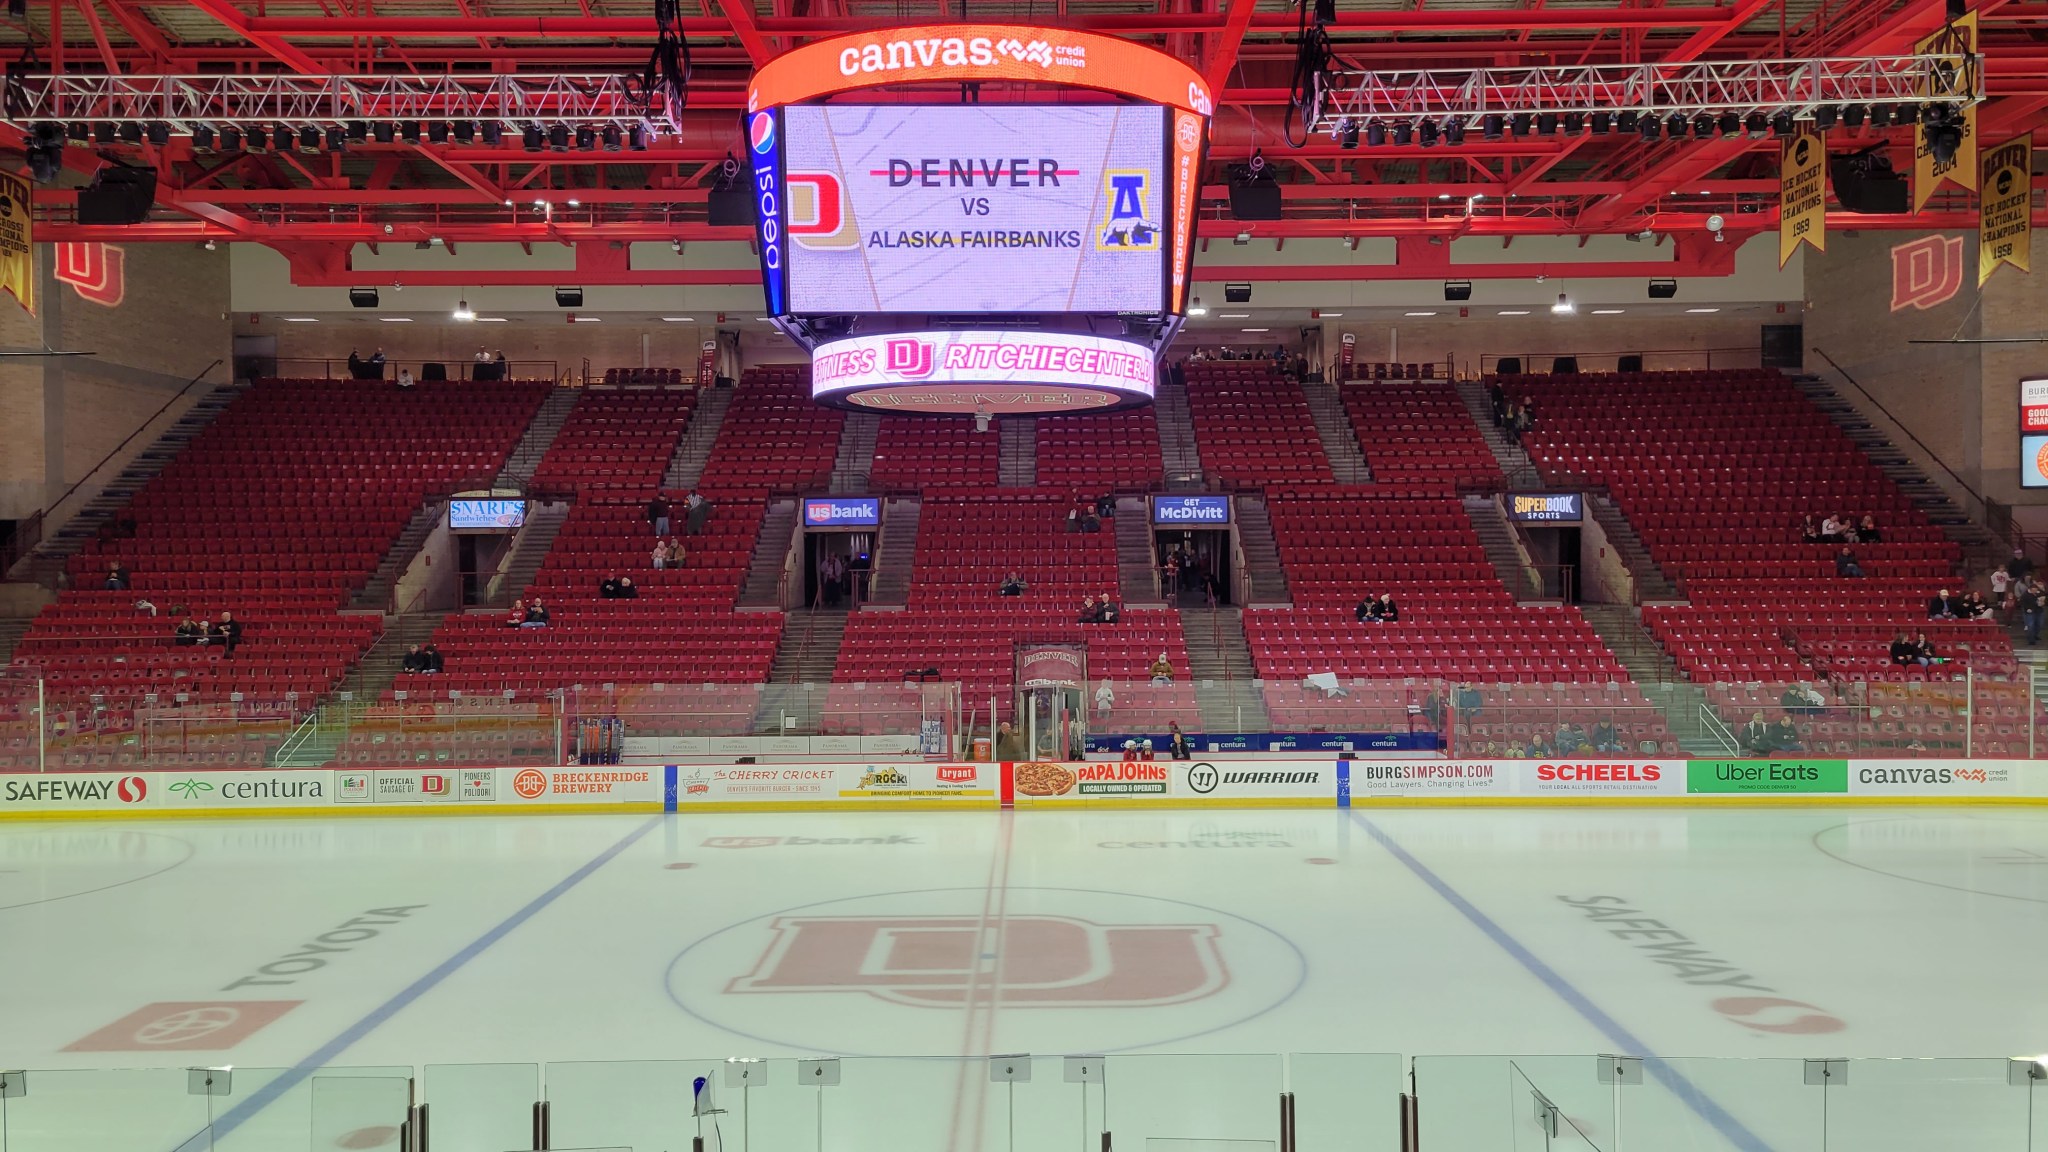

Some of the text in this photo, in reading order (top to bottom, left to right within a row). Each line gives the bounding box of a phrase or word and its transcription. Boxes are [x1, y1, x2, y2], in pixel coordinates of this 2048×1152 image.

[839, 37, 993, 76] canvas
[1055, 44, 1086, 57] credit
[1055, 56, 1086, 68] union
[888, 158, 1061, 188] DENVER
[1796, 163, 1822, 186] HOCKEY
[1983, 143, 2028, 190] DENVER
[1785, 181, 1819, 205] NATIONAL
[960, 198, 990, 216] VS
[1782, 194, 1822, 221] CHAMPIONS
[1996, 192, 2028, 213] HOCKEY
[756, 165, 779, 269] pepsi
[1172, 155, 1190, 287] #BRECKBREW
[1985, 208, 2023, 229] NATIONAL
[1793, 218, 1810, 238] 1969
[1983, 221, 2027, 244] CHAMPIONS
[868, 230, 1082, 249] ALASKA FAIRBANKS
[1993, 243, 2013, 260] 1958
[1160, 507, 1223, 519] McDivitt
[1514, 496, 1574, 514] SUPERBOOK
[1024, 651, 1079, 668] DENVER
[1321, 740, 1345, 748] centur
[464, 772, 491, 781] PIONEERS
[552, 772, 649, 783] BRECKENRIDGE
[714, 769, 834, 780] The CHERRY CRICKET
[941, 768, 973, 778] bryant
[1223, 772, 1319, 784] WARRIOR
[1366, 765, 1493, 779] BURGSIMPSON.COM
[1537, 764, 1661, 781] SCHEELS
[1716, 763, 1819, 780] Uber Eats
[1859, 768, 1951, 784] canvas
[5, 780, 114, 801] SAFEWAY
[221, 777, 323, 799] centura
[380, 785, 415, 794] SAUSAGE OF
[464, 788, 491, 797] POLIDORI
[552, 784, 613, 794] BREWERY
[1133, 784, 1162, 792] OPERATED
[1367, 781, 1387, 789] Good
[1390, 781, 1424, 789] Lawyers.
[1427, 780, 1465, 789] Changing
[1096, 839, 1296, 849] centura
[219, 903, 430, 992] TOYOTA
[1556, 894, 1778, 993] SAFEWAY
